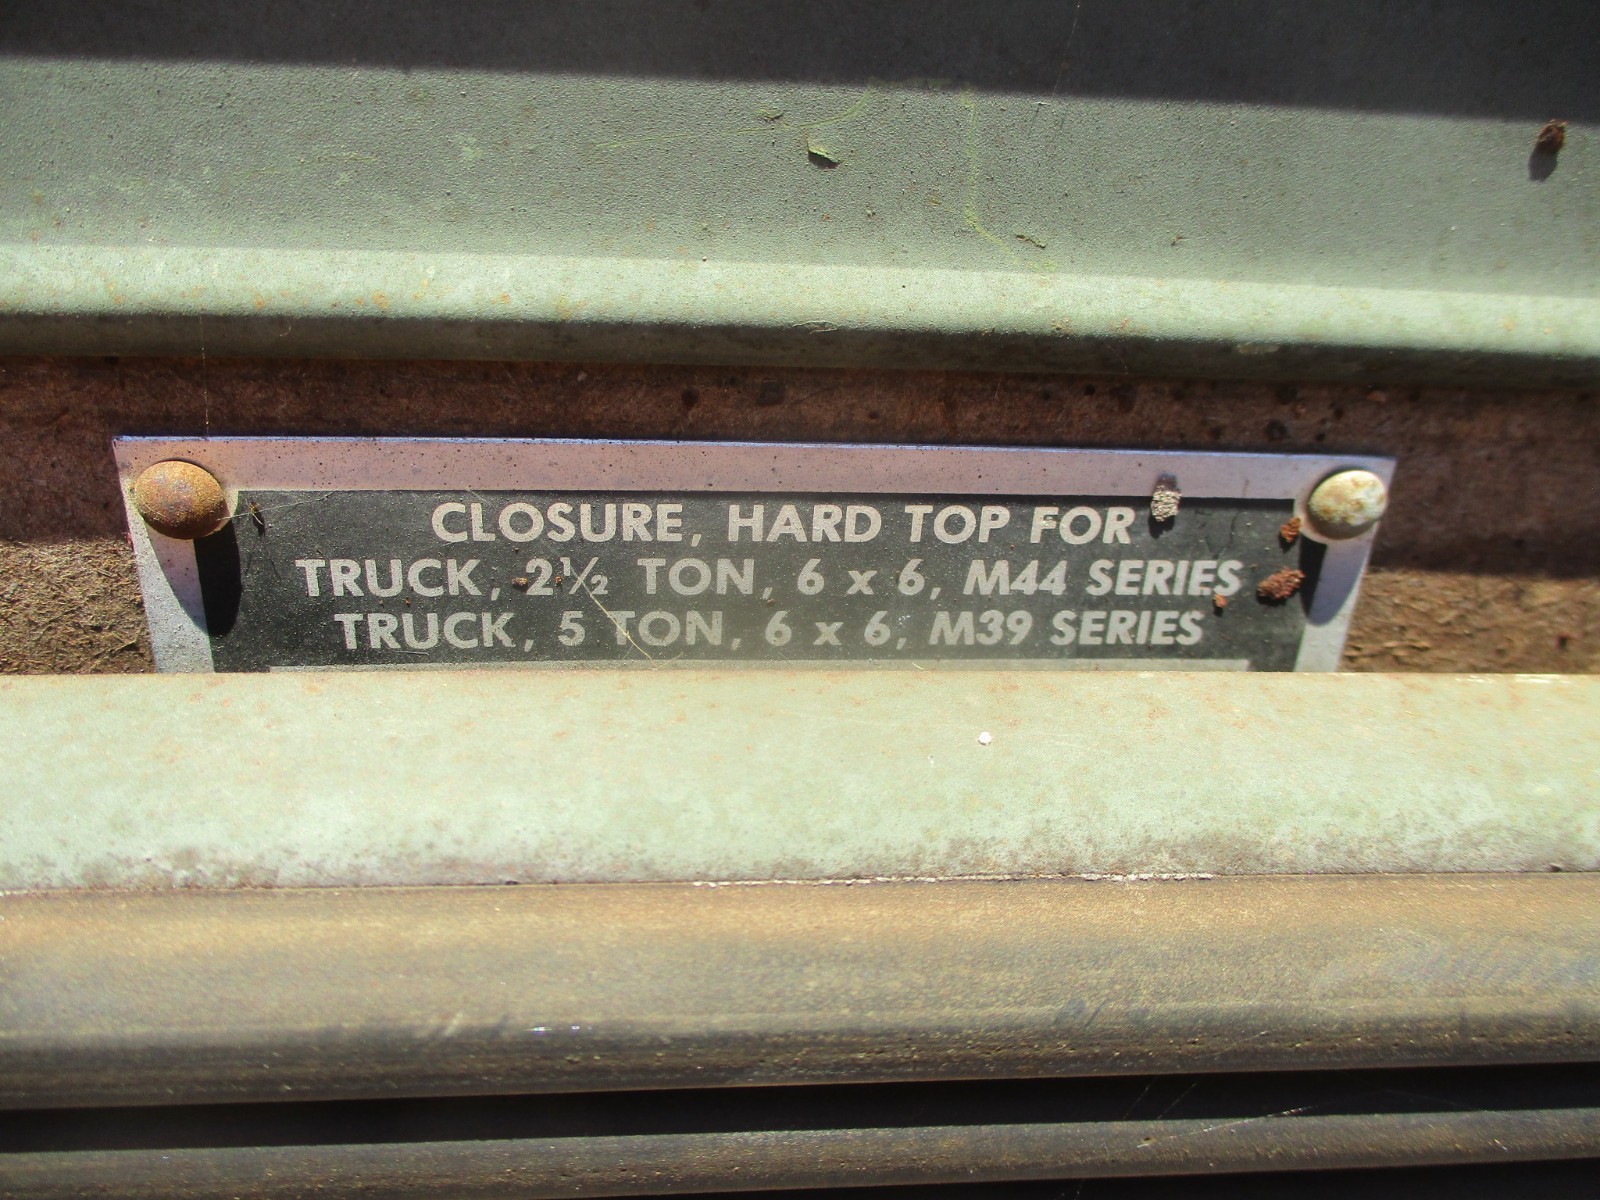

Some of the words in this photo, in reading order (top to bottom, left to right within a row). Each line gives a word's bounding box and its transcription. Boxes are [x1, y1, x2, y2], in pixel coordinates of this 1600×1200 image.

[431, 502, 700, 547] CLOSURE,
[729, 504, 882, 543] HARD
[906, 505, 1010, 544] TOP
[1030, 506, 1136, 545] FOR
[295, 558, 500, 601] TRUCK,
[637, 558, 772, 600] TON,
[797, 558, 824, 595] 6
[847, 570, 877, 595] x
[897, 558, 941, 600] 6,
[963, 559, 1067, 596] M44
[1085, 560, 1244, 596] SERIES
[335, 611, 534, 652] TRUCK,
[558, 610, 586, 646] 5
[614, 610, 741, 650] TON,
[765, 610, 792, 645] 6
[814, 620, 843, 645] x
[864, 610, 906, 649] 6,
[929, 610, 1035, 645] M39
[1050, 610, 1206, 645] SERIES
